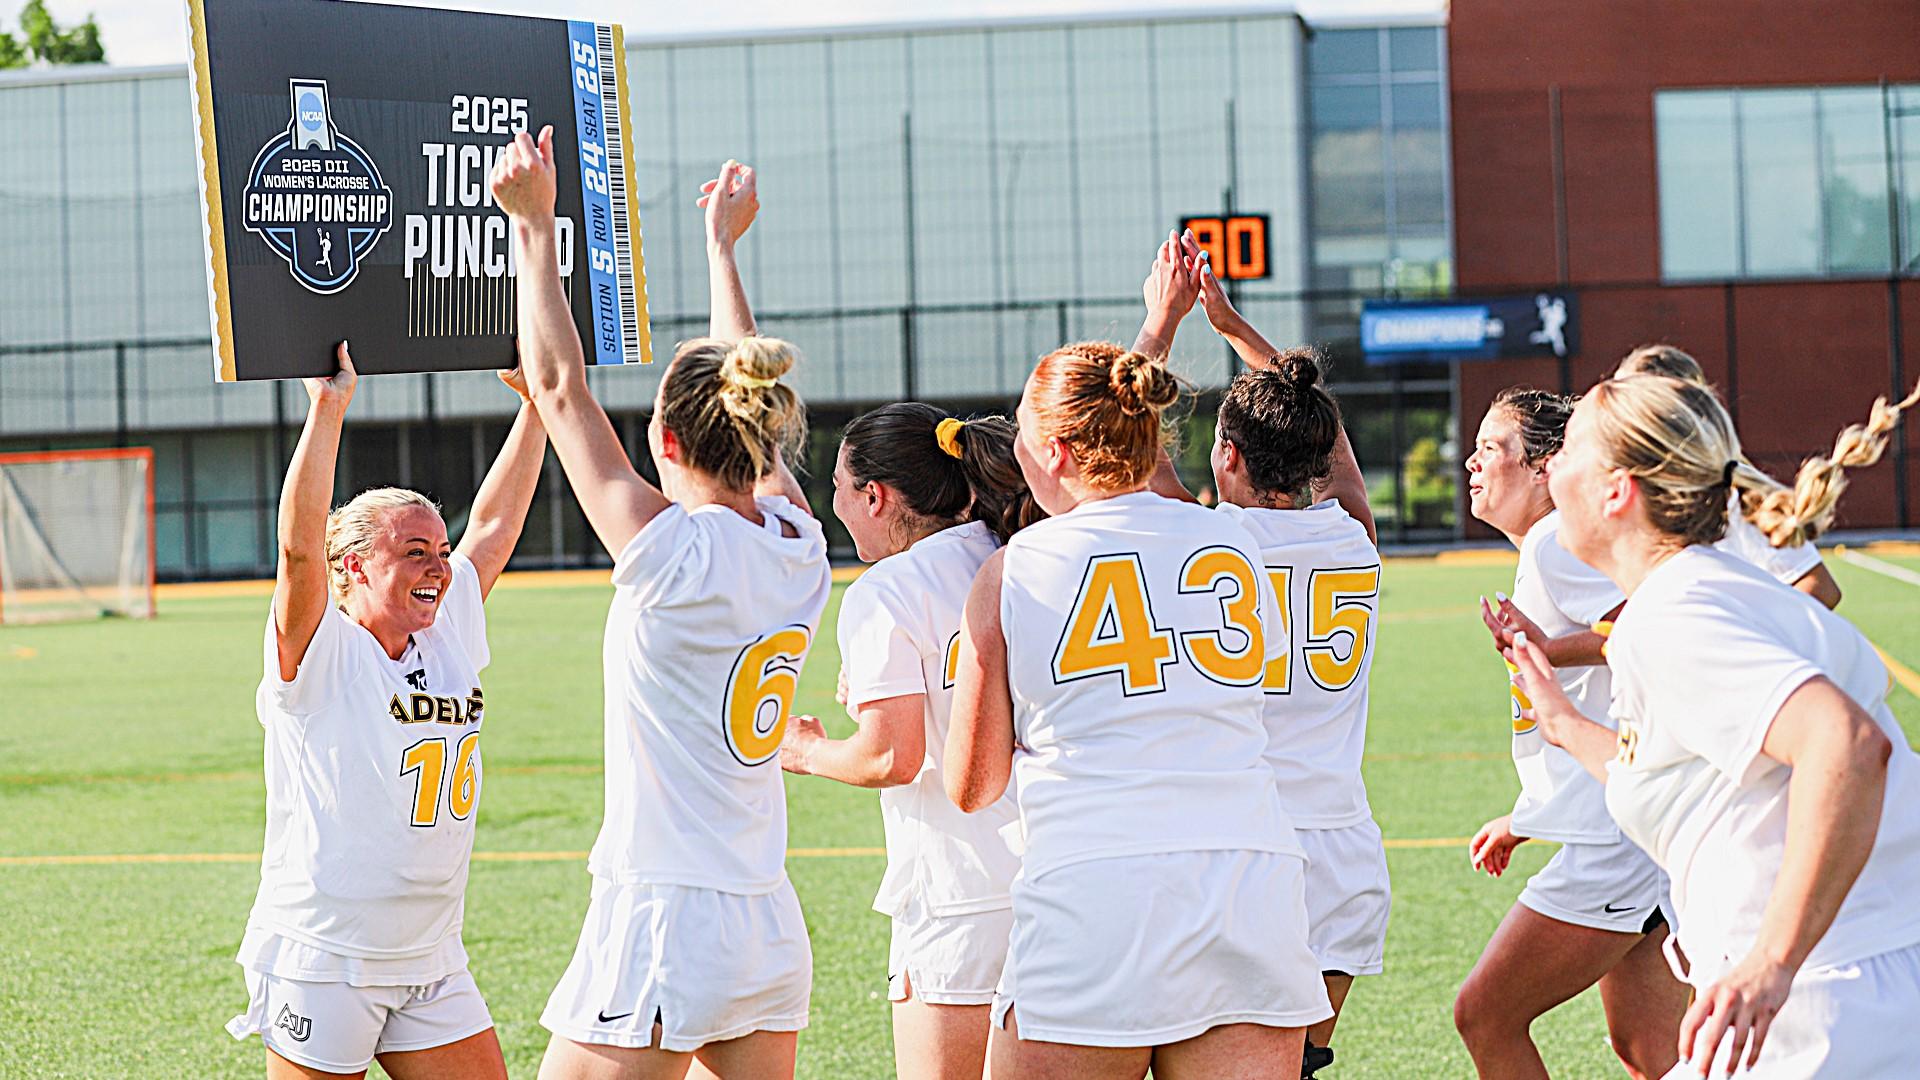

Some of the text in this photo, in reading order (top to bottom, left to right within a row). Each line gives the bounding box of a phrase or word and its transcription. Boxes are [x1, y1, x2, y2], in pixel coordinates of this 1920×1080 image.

[301, 111, 324, 122] NCAA
[452, 95, 528, 134] 2025
[263, 175, 369, 189] WOMEN'S LACROSSE
[282, 159, 349, 173] 2025 DII
[249, 193, 387, 222] CHAMPIONSHIP
[573, 39, 616, 352] SECTION 5 ROW 24 SEAT 25
[404, 214, 574, 278] PUNCD
[1051, 545, 1265, 697] 43
[722, 623, 811, 767] 6
[400, 731, 479, 827] 16
